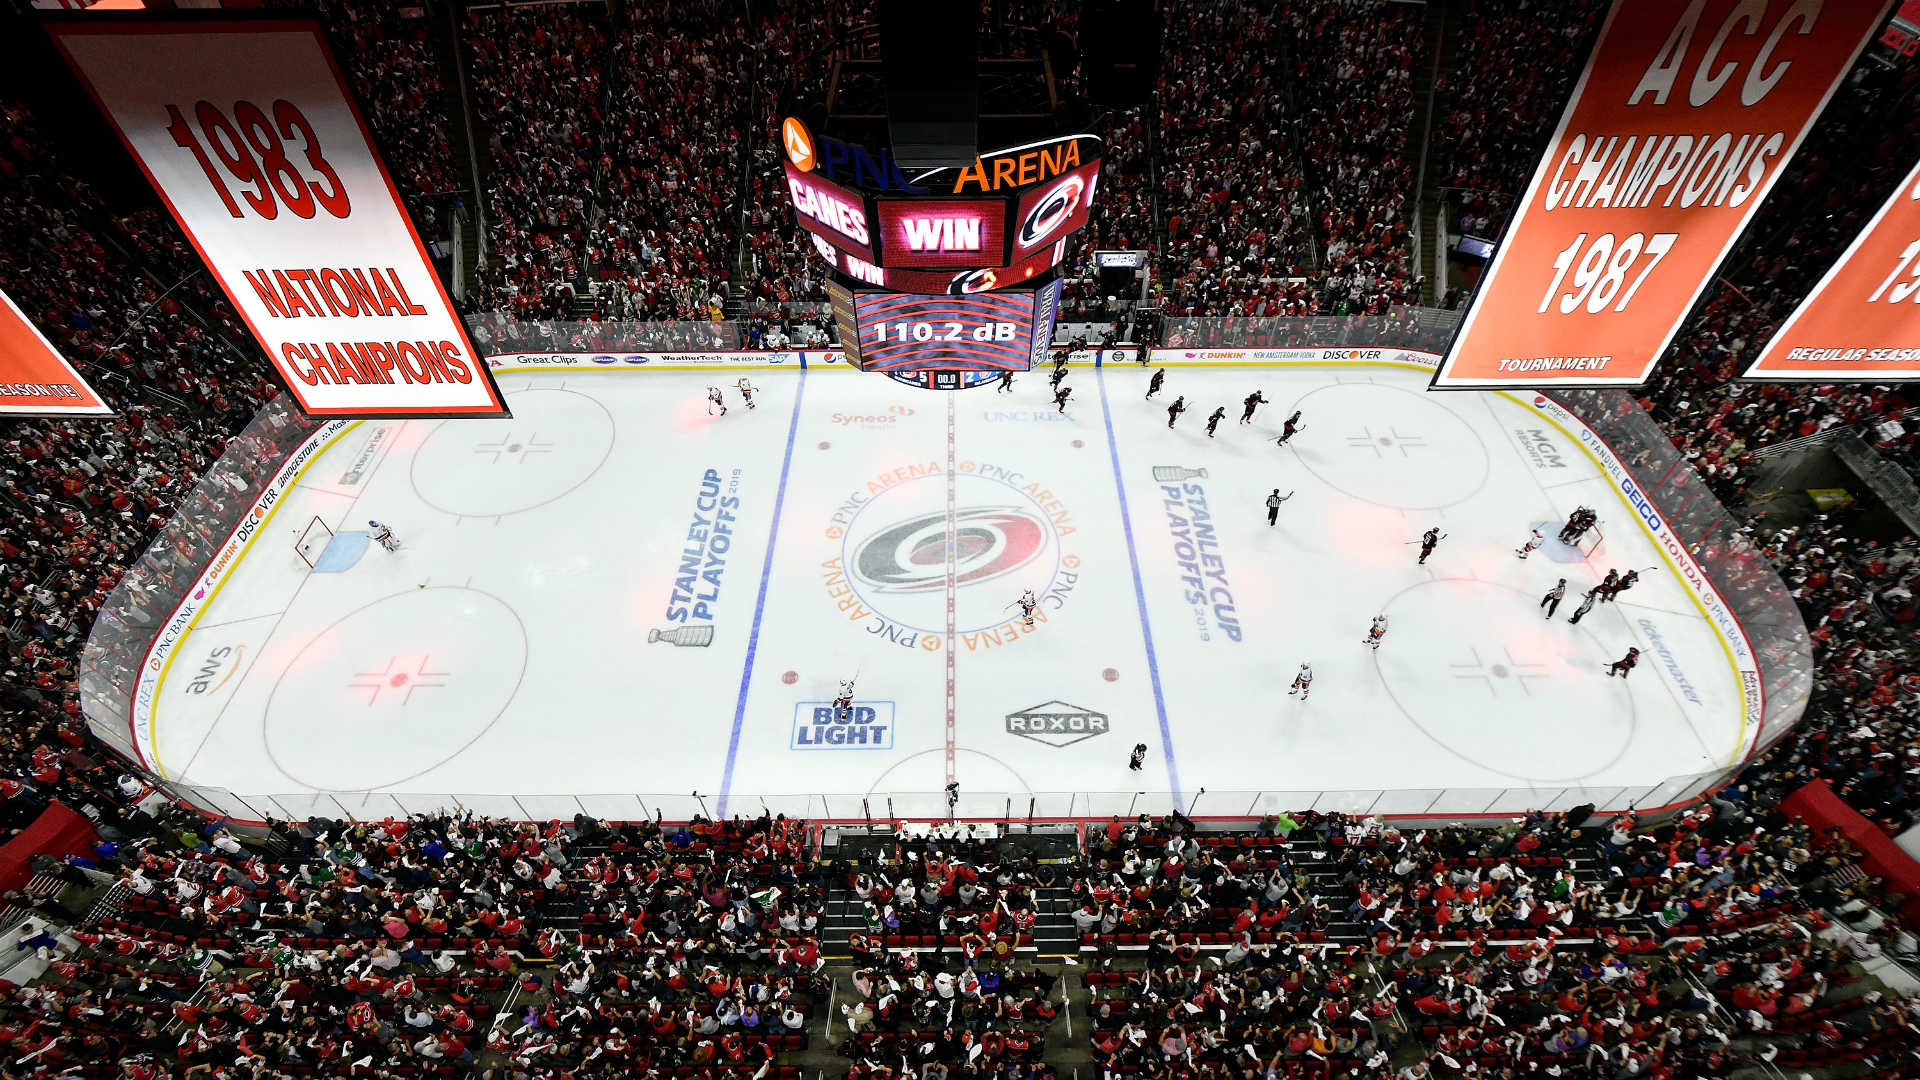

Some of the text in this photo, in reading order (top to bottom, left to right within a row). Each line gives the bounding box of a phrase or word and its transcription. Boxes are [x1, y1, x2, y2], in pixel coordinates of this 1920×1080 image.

[1627, 0, 1820, 107] ACC
[165, 100, 351, 220] 1983
[952, 139, 1080, 194] ARENA
[1545, 132, 1785, 211] CHAMPIONS
[788, 177, 871, 247] CANES
[903, 217, 982, 252] WIN
[242, 267, 428, 319] NATIONAL
[847, 254, 885, 287] WIN
[1537, 233, 1680, 315] 1987
[873, 322, 1017, 342] 110.2 dB
[1253, 351, 1265, 359] NEW
[1323, 350, 1381, 360] DISCOVER
[1786, 348, 1868, 361] REGULAR
[281, 340, 473, 386] CHAMPIONS
[516, 355, 578, 366] Great Clips
[768, 355, 787, 363] SAP
[966, 371, 974, 383] 2
[1405, 353, 1434, 365] Coors
[1498, 356, 1612, 372] TOURNAMENT
[831, 412, 897, 426] Syneos
[983, 410, 1076, 423] UNC REX
[277, 438, 320, 488] BRIDGESTONE
[1527, 429, 1567, 468] MGM
[1590, 439, 1622, 480] FANDUEL
[237, 488, 278, 543] DISCOVER
[831, 460, 942, 525] PNC ARENA
[978, 462, 1077, 537] PNC ARENA
[1620, 477, 1662, 532] GEICO
[666, 468, 722, 624] STANLEY CUP
[691, 467, 742, 621] PLAYOFFS 2019
[1160, 485, 1211, 642] PLAYOFFS 2019
[1182, 482, 1243, 643] STANLEY CUP
[1659, 531, 1704, 593] HONDA
[821, 556, 918, 649] PNC ARENA
[1042, 570, 1079, 611] PNC
[185, 646, 232, 695] aws
[797, 725, 888, 745] LIGHT
[813, 706, 876, 725] BUD
[1009, 717, 1106, 732] ROXOR
